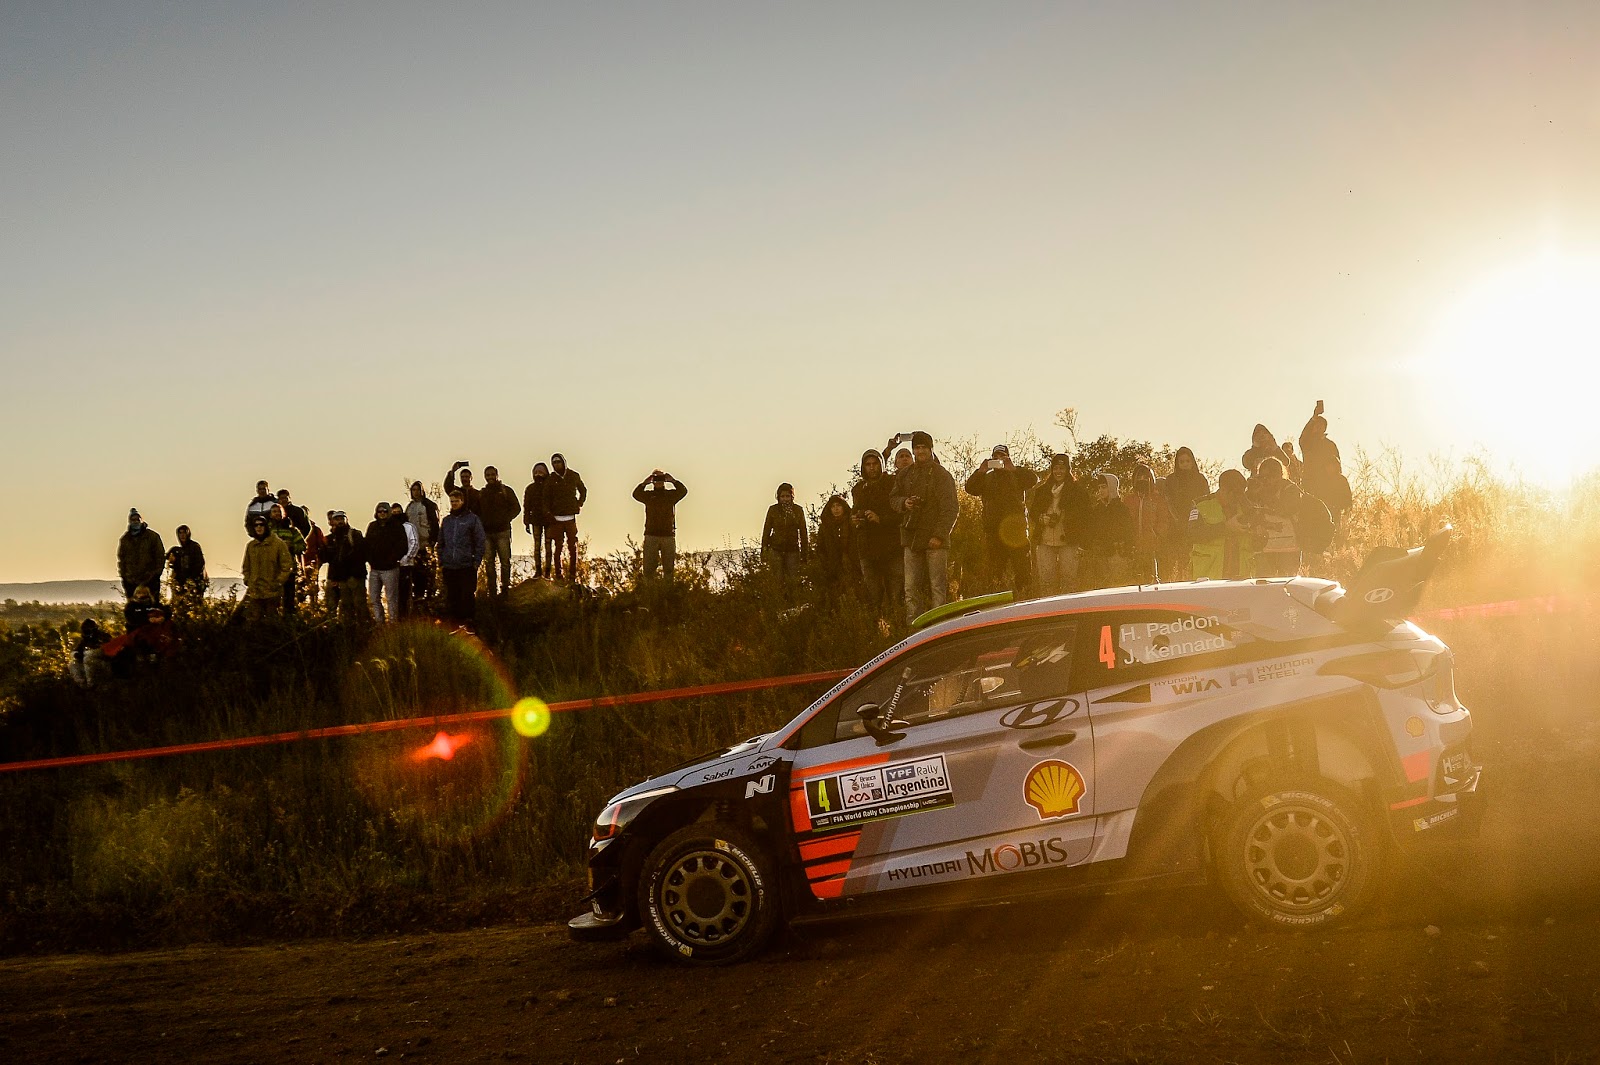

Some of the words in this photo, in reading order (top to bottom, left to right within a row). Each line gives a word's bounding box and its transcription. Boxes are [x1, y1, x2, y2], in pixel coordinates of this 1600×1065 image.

[1120, 628, 1141, 643] H.
[1146, 614, 1221, 638] Paddon
[1099, 625, 1116, 669] 4
[1123, 649, 1140, 665] J.
[1145, 633, 1225, 659] Kennard
[1256, 657, 1315, 674] HYUNDAI
[1257, 668, 1301, 682] STEEL
[809, 640, 909, 712] motorsport.hyundai.com
[1153, 675, 1199, 687] HYUNDAI
[1171, 678, 1223, 696] WIA
[702, 768, 735, 782] Sabelt
[887, 768, 913, 779] YPF
[916, 764, 939, 776] Rally
[887, 775, 945, 796] Argentina
[818, 780, 830, 812] 4
[848, 792, 870, 803] ACA
[844, 812, 862, 821] World
[863, 809, 878, 818] Rally
[879, 802, 920, 815] Championship
[731, 848, 763, 887] MICHELIN
[888, 860, 962, 881] HYUNDAI
[965, 837, 1068, 876] MOBIS
